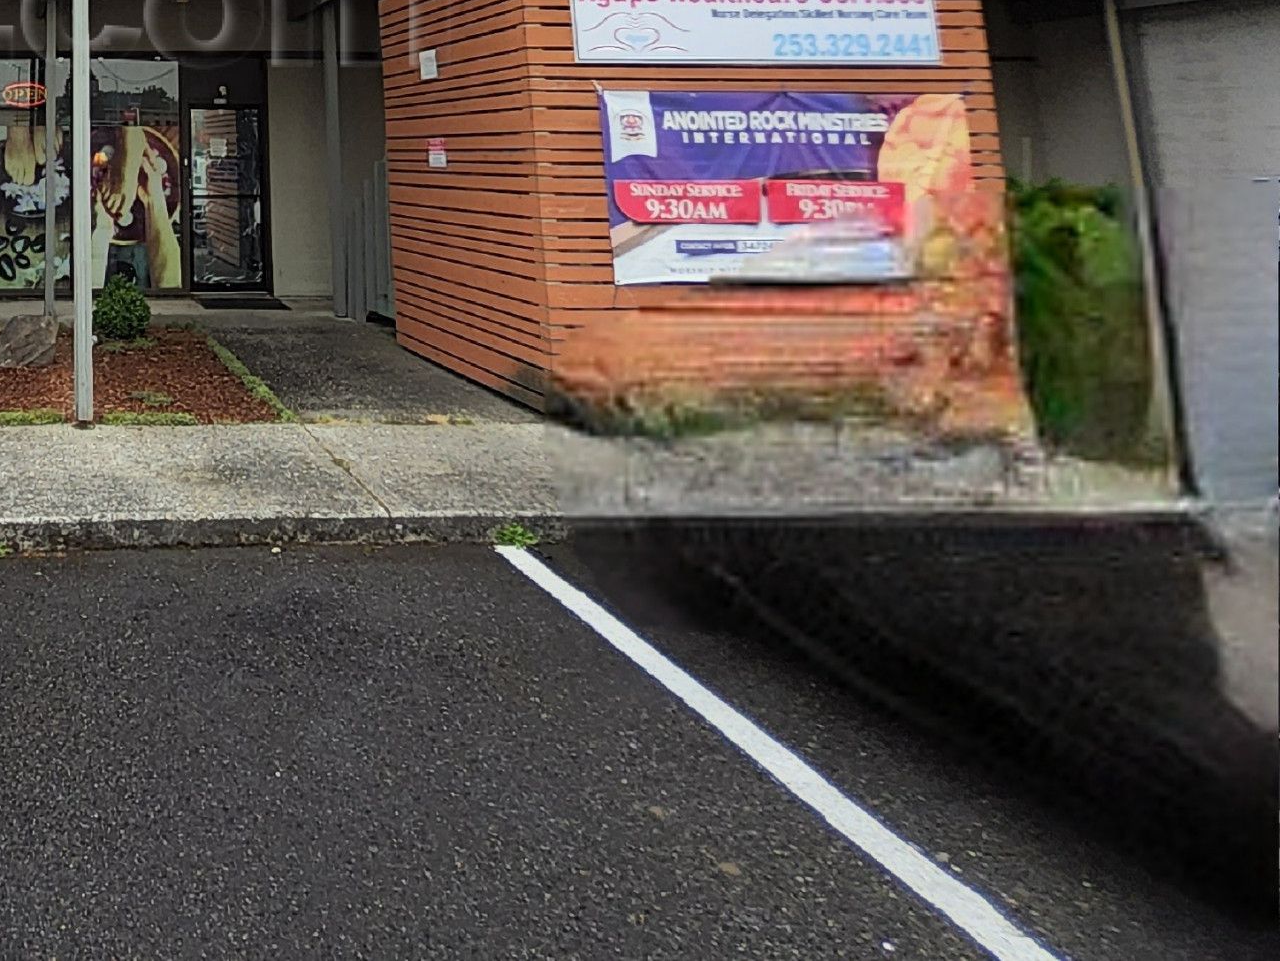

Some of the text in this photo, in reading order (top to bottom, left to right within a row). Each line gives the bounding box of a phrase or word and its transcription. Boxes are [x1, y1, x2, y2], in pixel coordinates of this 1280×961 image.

[772, 33, 933, 57] 253.329.2441
[3, 88, 47, 103] OPEN
[662, 110, 889, 132] ANOINTED ROCK MINISTRIES
[681, 131, 872, 145] INTERNATIONAL
[629, 183, 684, 196] SUNDAY
[646, 199, 728, 219] 9:30AM
